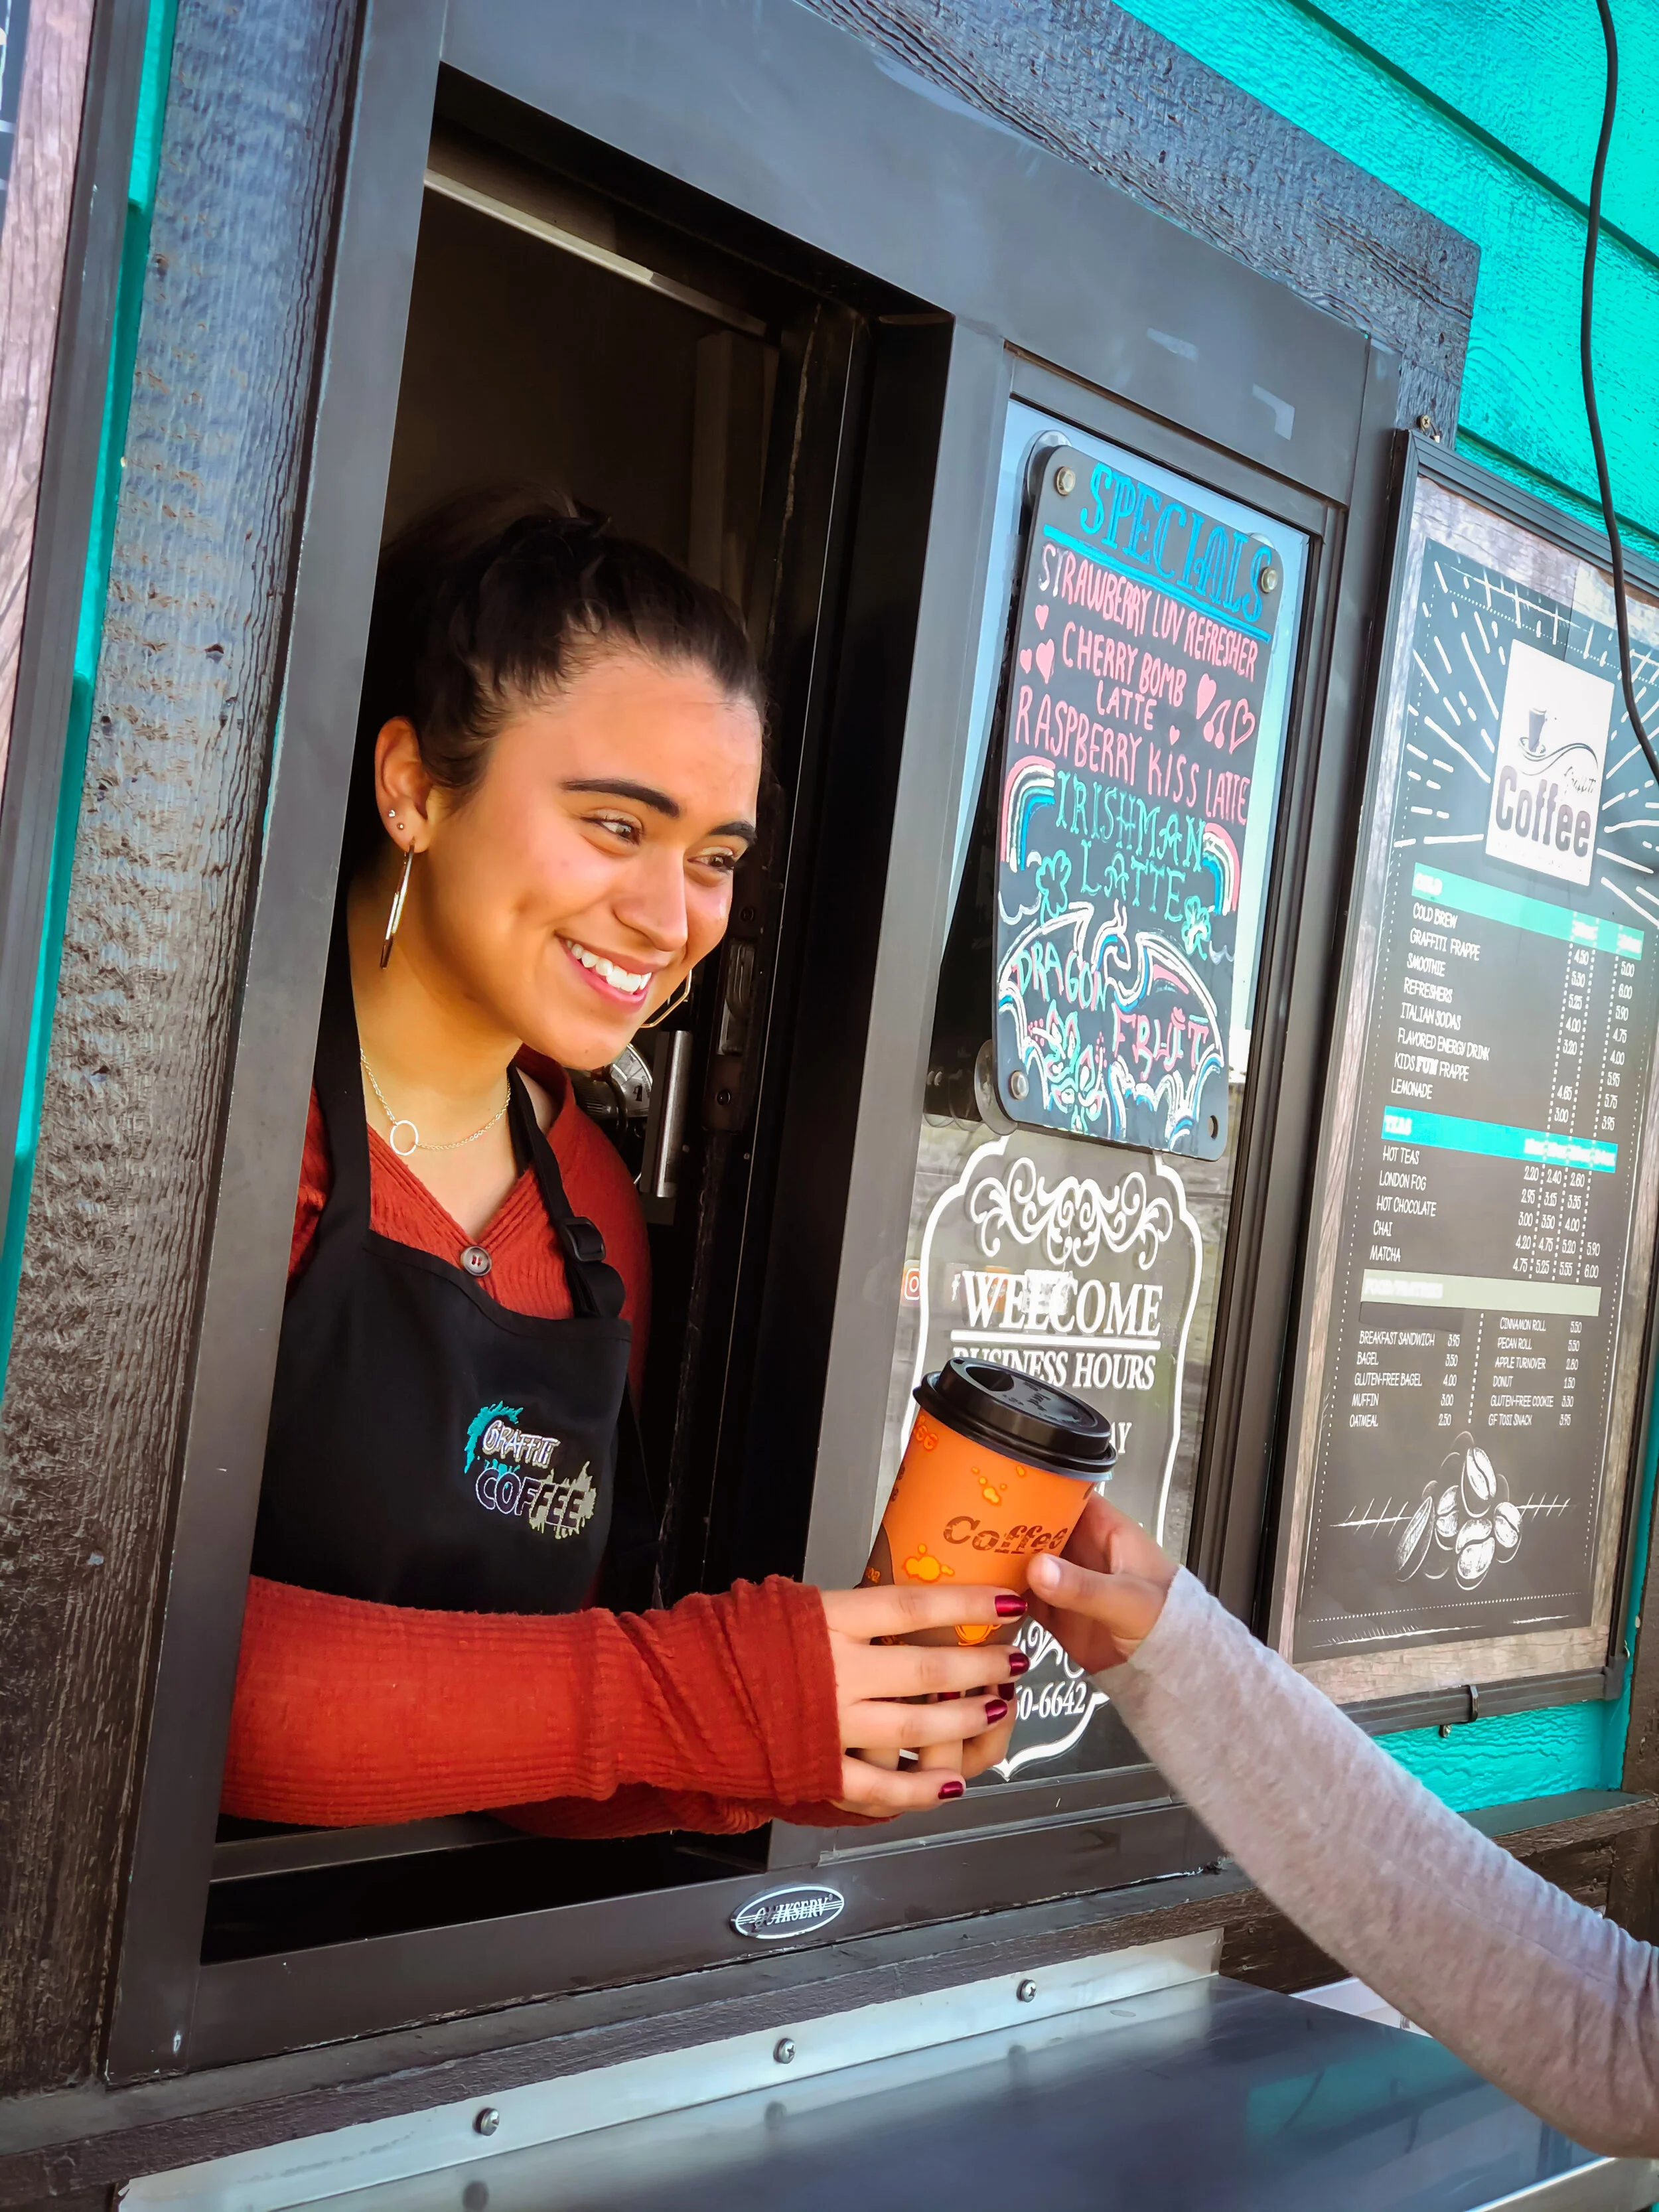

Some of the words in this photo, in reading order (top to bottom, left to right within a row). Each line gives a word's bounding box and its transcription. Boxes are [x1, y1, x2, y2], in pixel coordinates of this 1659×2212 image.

[1080, 463, 1271, 622] SPECIALS
[1038, 543, 1151, 636] STRAWBERRY
[1153, 595, 1185, 644] LUV
[1185, 612, 1258, 682] REFRESHER
[1062, 621, 1138, 684] CHERRY
[1139, 652, 1187, 707] BOMB
[1097, 680, 1158, 729] LATTE
[1015, 686, 1142, 785] RASPBERRY
[1148, 742, 1199, 807] KISS
[1205, 769, 1250, 825] LATTE
[1056, 771, 1206, 871] IRISHMAN
[1496, 765, 1592, 857] Coffee
[1080, 840, 1185, 921] LATTE
[1413, 902, 1433, 922] COLD
[1433, 909, 1459, 929] BREW
[1409, 927, 1447, 952] GRAFFITI
[1450, 940, 1480, 961] FRAPPE
[1407, 952, 1447, 978] SMOOTHIE
[1574, 949, 1589, 966] 4.50
[1621, 961, 1635, 978] 5.00
[1011, 941, 1108, 1011] DRAGON
[1571, 970, 1585, 988] 5.30
[1619, 983, 1632, 999] 6.00
[1404, 977, 1453, 1003] REFRESHERS
[1400, 1002, 1435, 1024] ITALIAN
[1435, 1010, 1461, 1031] SODAS
[1568, 994, 1583, 1010] 5.25
[1615, 1005, 1629, 1021] 5.90
[1565, 1017, 1581, 1034] 4.00
[1613, 1027, 1627, 1044] 4.75
[1112, 1003, 1208, 1081] FRUIT
[1398, 1027, 1437, 1050] FLAVORED
[1437, 1036, 1467, 1056] ENERGY
[1467, 1042, 1490, 1061] DRINK
[1563, 1039, 1577, 1056] 3.20
[1610, 1051, 1625, 1067] 4.00
[1394, 1052, 1415, 1072] KIDS
[1439, 1061, 1470, 1082] FRAPPE
[1391, 1077, 1433, 1100] LEMONADE
[1607, 1072, 1621, 1087] 5.95
[1604, 1093, 1618, 1110] 5.75
[1554, 1107, 1569, 1124] 3.00
[1601, 1115, 1615, 1132] 3.95
[1383, 1145, 1399, 1161] HOT
[1400, 1147, 1420, 1165] TEAS
[1379, 1170, 1410, 1189] LONDON
[1411, 1175, 1427, 1191] FOG
[1524, 1165, 1539, 1181] 2.20
[1546, 1170, 1562, 1185] 2.40
[1570, 1172, 1585, 1187] 2.60
[1377, 1195, 1393, 1211] HOT
[1393, 1197, 1437, 1217] CHOCOLATE
[1521, 1189, 1536, 1204] 2.95
[1544, 1192, 1557, 1207] 3.15
[1567, 1195, 1581, 1210] 3.35
[1373, 1220, 1393, 1236] CHAI
[1518, 1212, 1533, 1227] 3.00
[1541, 1215, 1555, 1229] 3.50
[1565, 1217, 1580, 1232] 4.00
[1370, 1245, 1401, 1262] MATCHA
[1516, 1235, 1532, 1250] 4.20
[1538, 1237, 1553, 1252] 4.75
[1562, 1239, 1576, 1254] 5.20
[1587, 1242, 1601, 1256] 5.90
[1513, 1258, 1528, 1273] 4.75
[1536, 1260, 1550, 1275] 5.25
[1559, 1262, 1573, 1276] 5.55
[1584, 1264, 1599, 1279] 6.00
[962, 1270, 1163, 1337] WELCOME
[1500, 1317, 1532, 1331] CINNAMON
[1532, 1319, 1546, 1331] ROLL
[1359, 1331, 1398, 1345] BREAKFAST
[1398, 1331, 1435, 1347] SANDWICH
[1447, 1334, 1461, 1347] 3.95
[1498, 1337, 1517, 1349] PECAN
[1518, 1338, 1532, 1350] ROLL
[1356, 1351, 1379, 1366] BAGEL
[1445, 1354, 1458, 1367] 3.50
[1494, 1357, 1515, 1369] APPLE
[1516, 1357, 1546, 1370] TURNOVER
[1074, 1352, 1155, 1390] HOURS
[1354, 1372, 1400, 1386] GLUTEN-FREE
[1400, 1373, 1423, 1386] BAGEL
[1443, 1374, 1457, 1386] 4.00
[1493, 1376, 1514, 1388] DONUT
[1352, 1393, 1380, 1407] MUFFIN
[1441, 1394, 1454, 1406] 3.00
[1490, 1394, 1532, 1408] GLUTEN-FREE
[1532, 1396, 1554, 1408] COOKIE
[1349, 1414, 1378, 1428] OATMEAL
[1438, 1414, 1451, 1426] 2.50
[1513, 1414, 1533, 1426] SNACK
[476, 1467, 586, 1529] COFFEE
[943, 1516, 1068, 1554] Coffee
